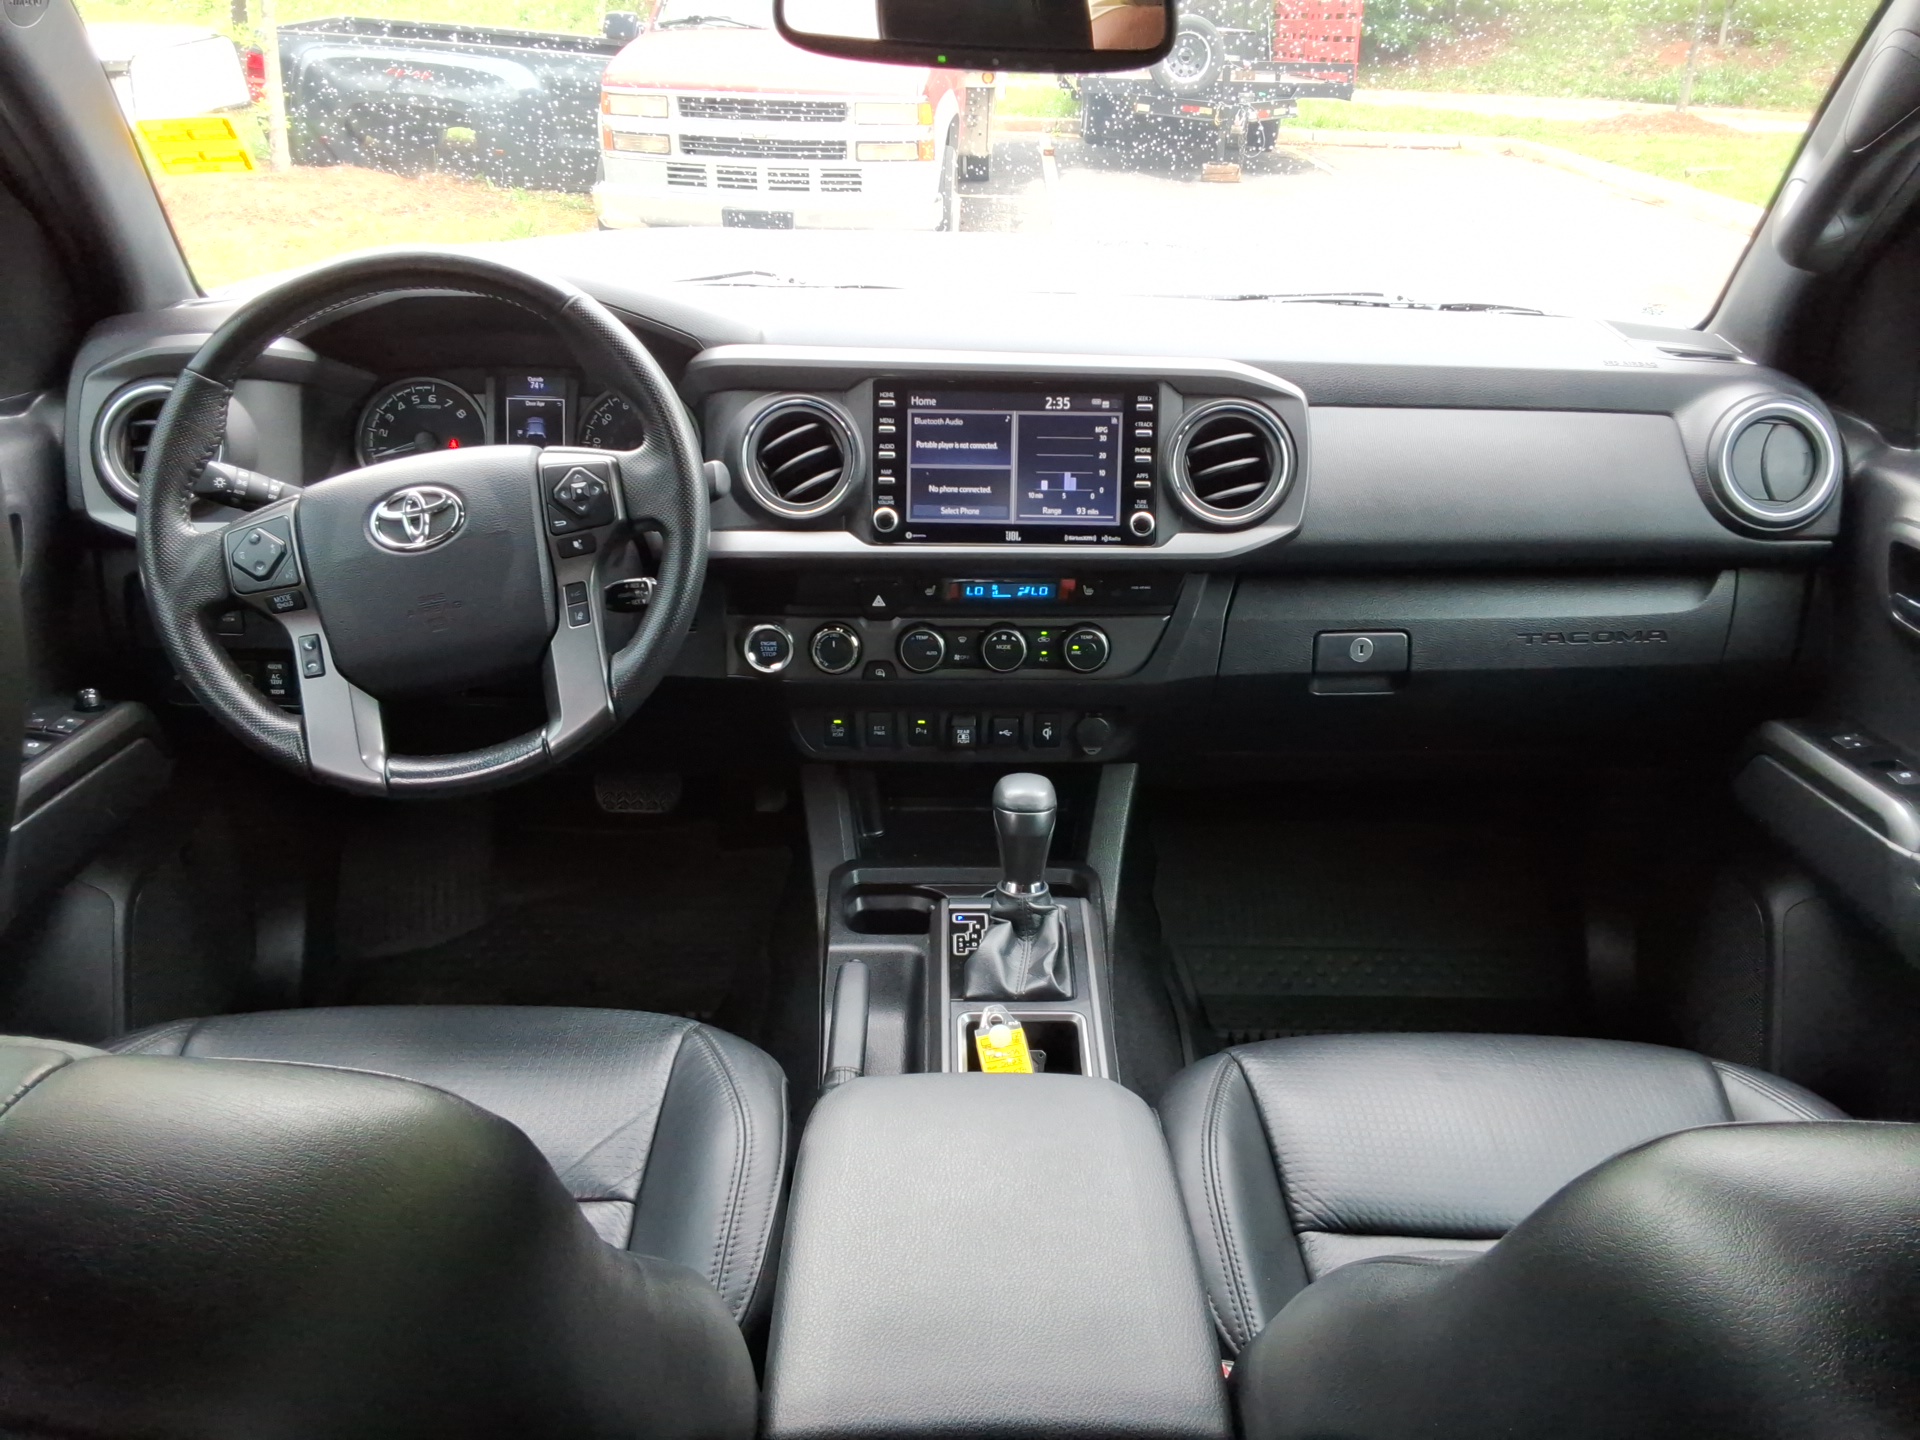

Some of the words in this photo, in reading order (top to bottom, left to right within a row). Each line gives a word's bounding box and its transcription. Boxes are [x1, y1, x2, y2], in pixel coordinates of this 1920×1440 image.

[411, 395, 420, 405] 5
[428, 394, 437, 403] 6
[444, 398, 454, 408] 7
[910, 396, 937, 406] Home
[1045, 396, 1071, 410] 2:35
[397, 401, 406, 411] 4
[385, 413, 395, 422] 3
[455, 409, 467, 419] 8
[601, 413, 613, 426] 40
[914, 417, 944, 426] Bluetooth
[944, 418, 963, 426] Audio
[1099, 434, 1107, 442] 30
[915, 440, 937, 450] Portable
[938, 441, 954, 450] player
[1098, 469, 1106, 477] 10
[928, 484, 939, 493] No
[939, 486, 958, 494] phone
[959, 486, 992, 494] connected.
[1098, 486, 1104, 494] 0
[1028, 491, 1035, 499] 10
[1061, 492, 1067, 500] 5
[1089, 492, 1096, 500] 0
[940, 507, 960, 515] Select
[960, 507, 980, 515] Phone
[1042, 507, 1062, 516] Range
[1076, 507, 1087, 515] 93
[1005, 531, 1021, 541] JBL
[966, 586, 984, 596] LO
[1031, 586, 1049, 596] LO
[273, 595, 292, 603] MODE
[1516, 629, 1668, 646] TACOMA
